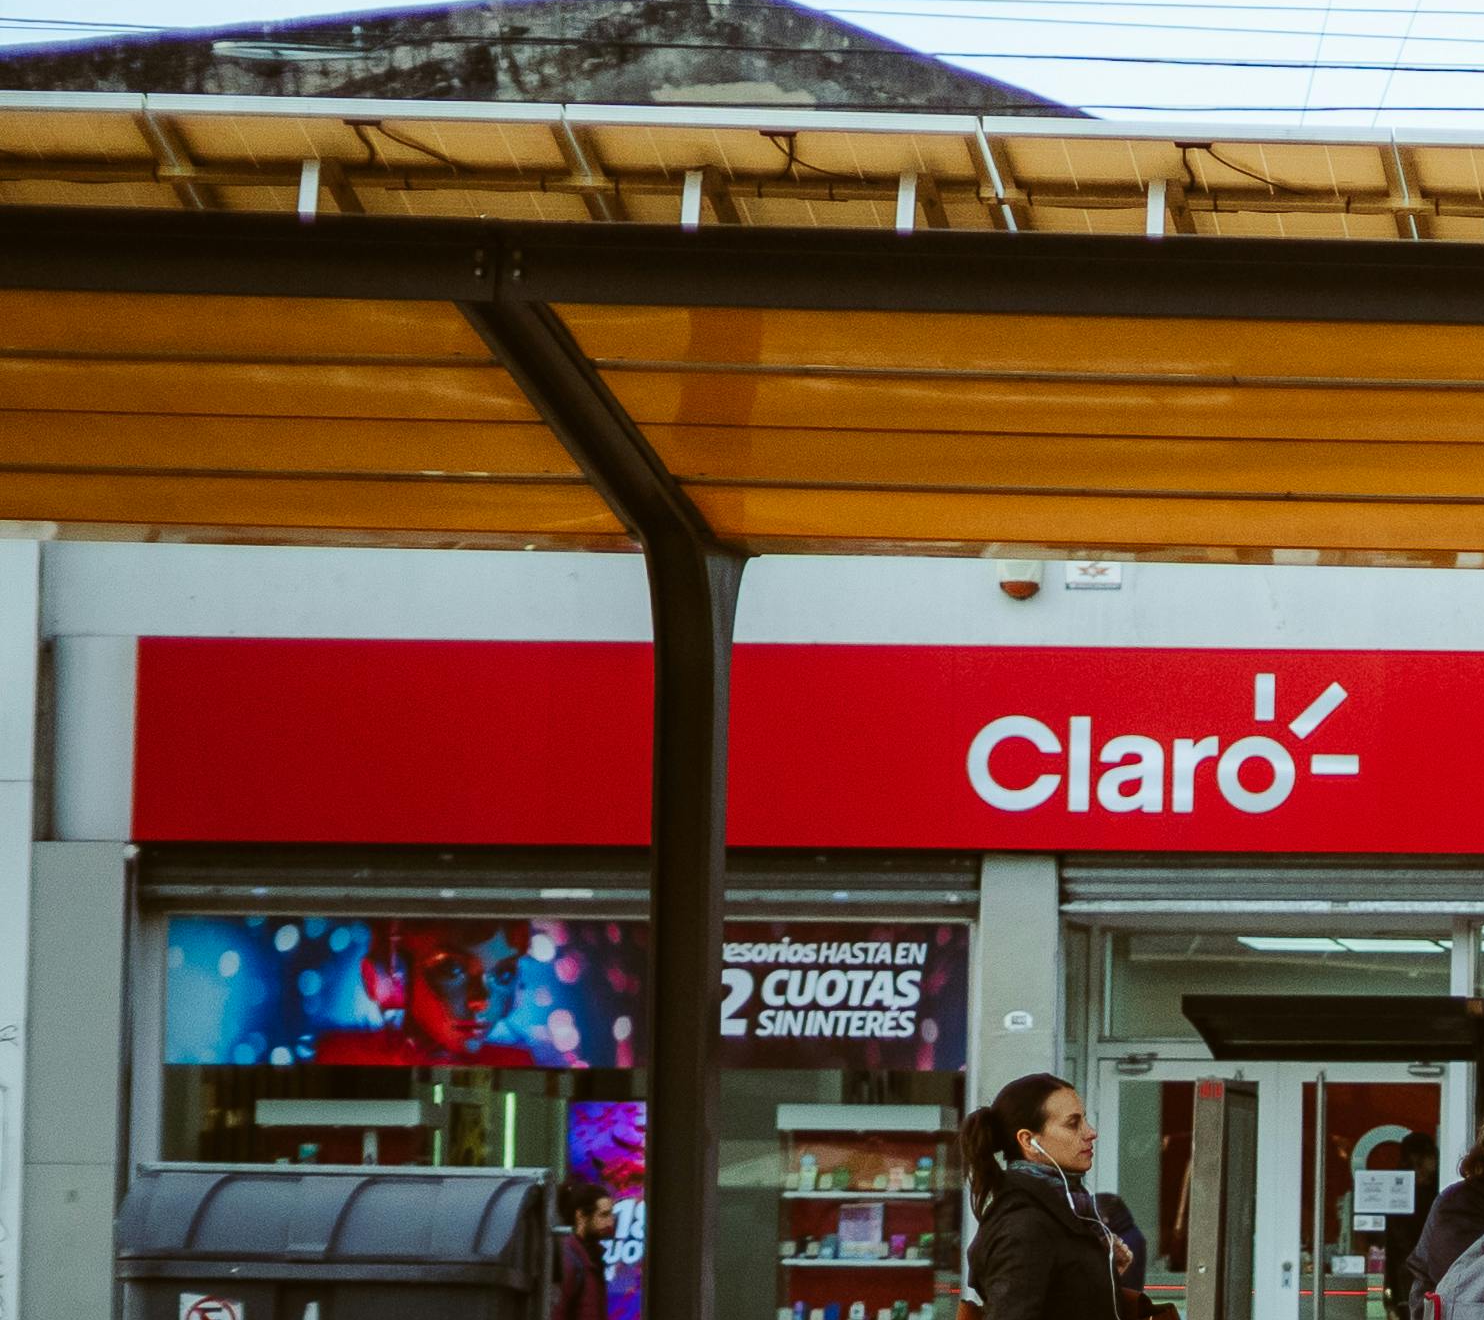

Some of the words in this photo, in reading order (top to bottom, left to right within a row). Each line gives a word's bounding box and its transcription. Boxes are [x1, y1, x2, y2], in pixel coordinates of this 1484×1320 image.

[967, 715, 1296, 813] Claro
[722, 936, 818, 964] esorios
[817, 942, 893, 965] HASTA
[894, 942, 927, 965] EN
[761, 969, 922, 1008] CUOTAS
[755, 1010, 803, 1037] SIN
[803, 1006, 916, 1038] INTERÉS
